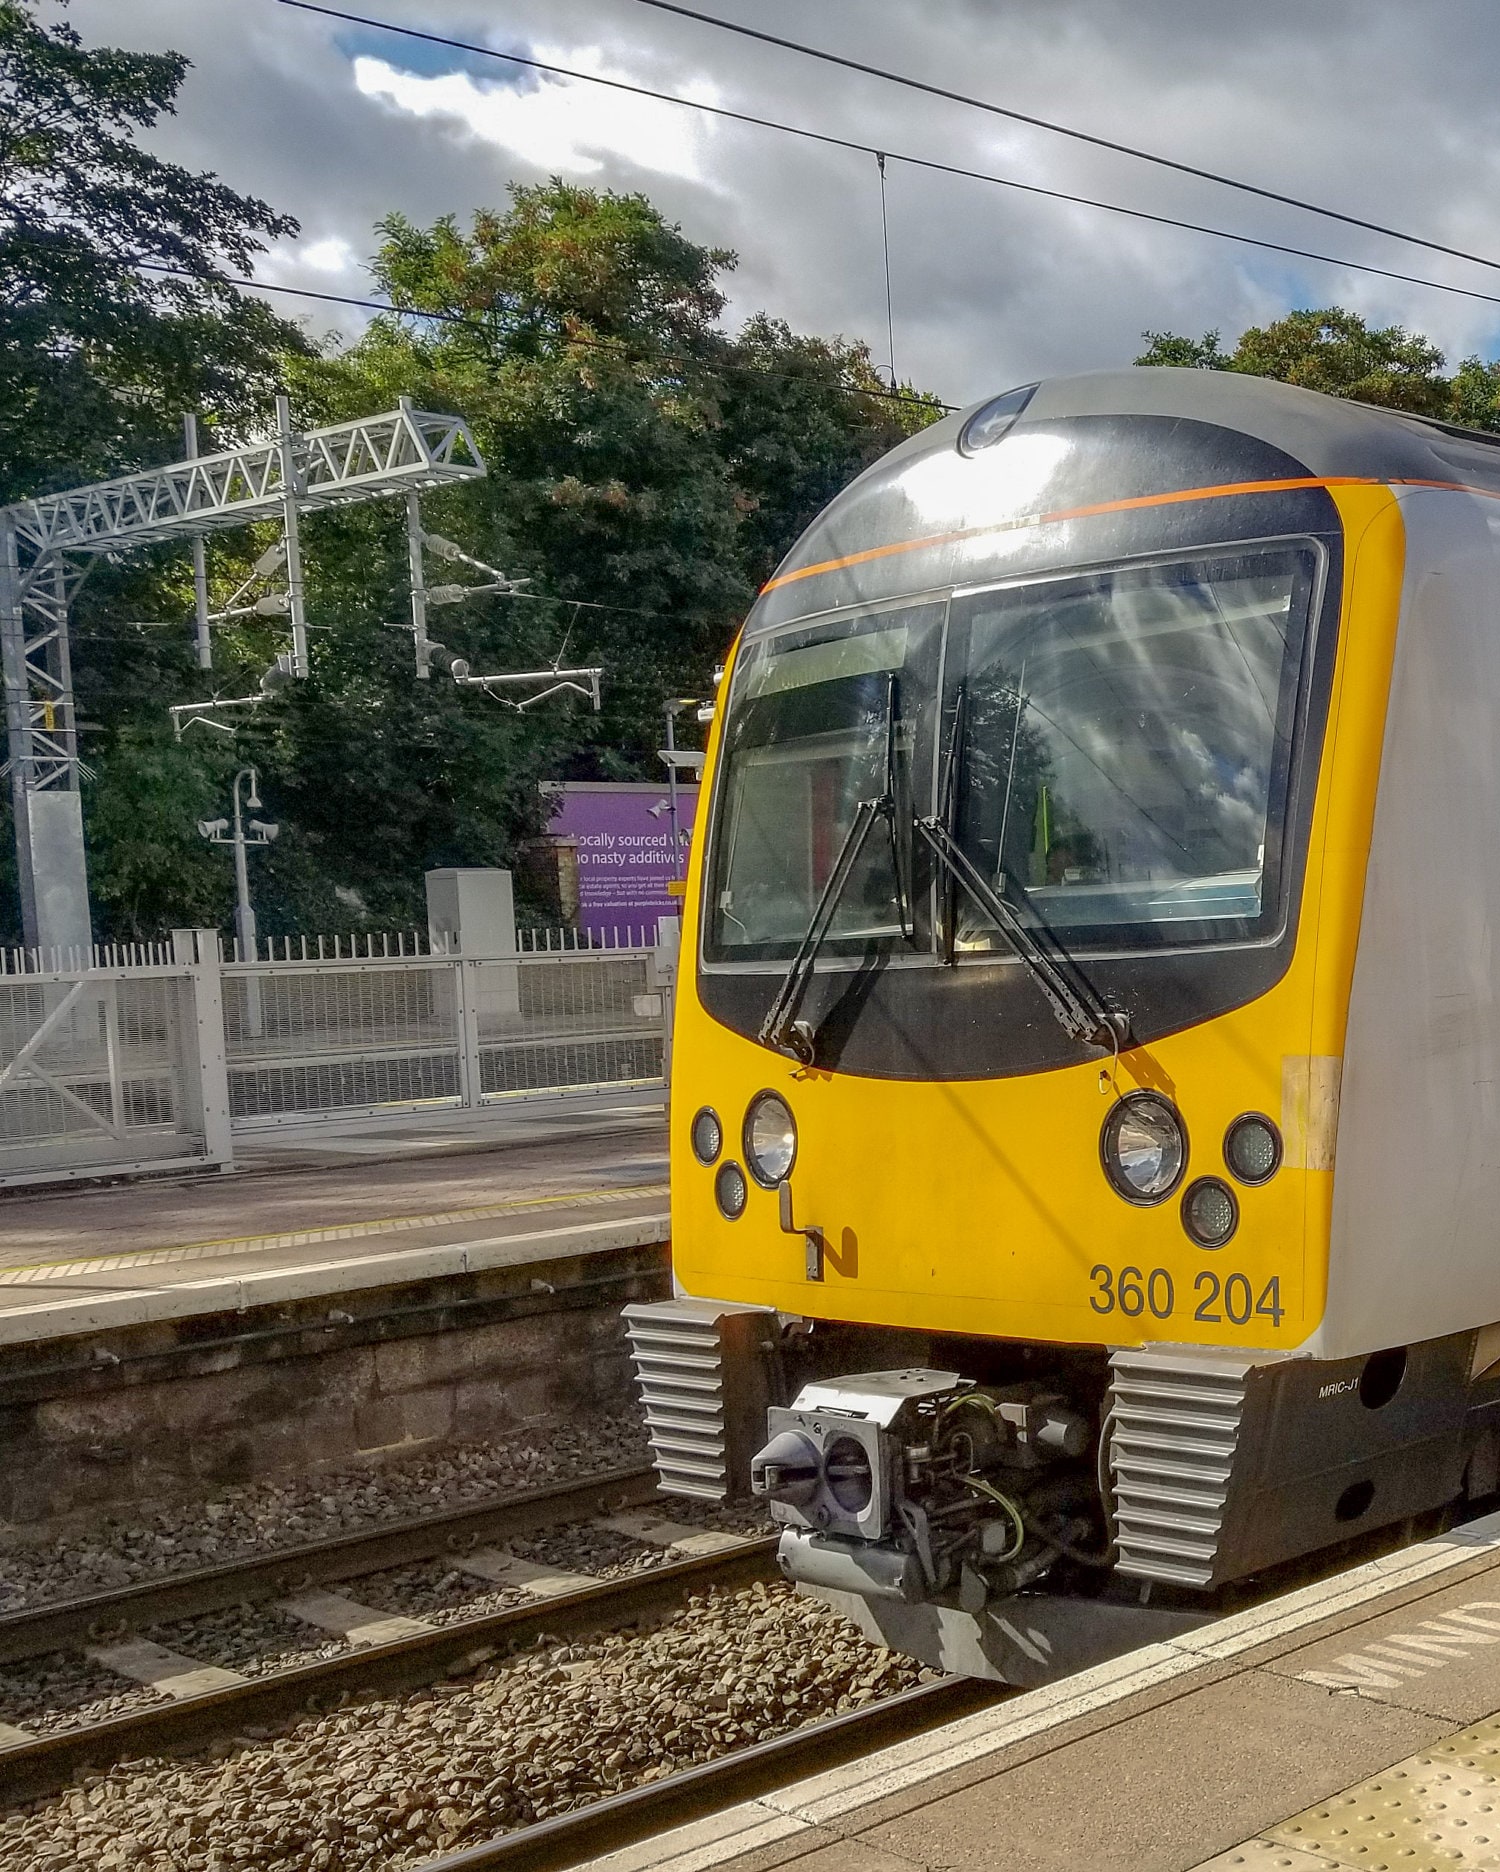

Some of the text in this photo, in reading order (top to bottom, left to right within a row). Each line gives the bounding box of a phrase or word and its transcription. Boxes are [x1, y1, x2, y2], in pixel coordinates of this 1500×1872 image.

[571, 833, 616, 849] ocally
[618, 833, 667, 846] sourced
[592, 852, 626, 867] nasty
[1089, 1263, 1286, 1328] 360 204
